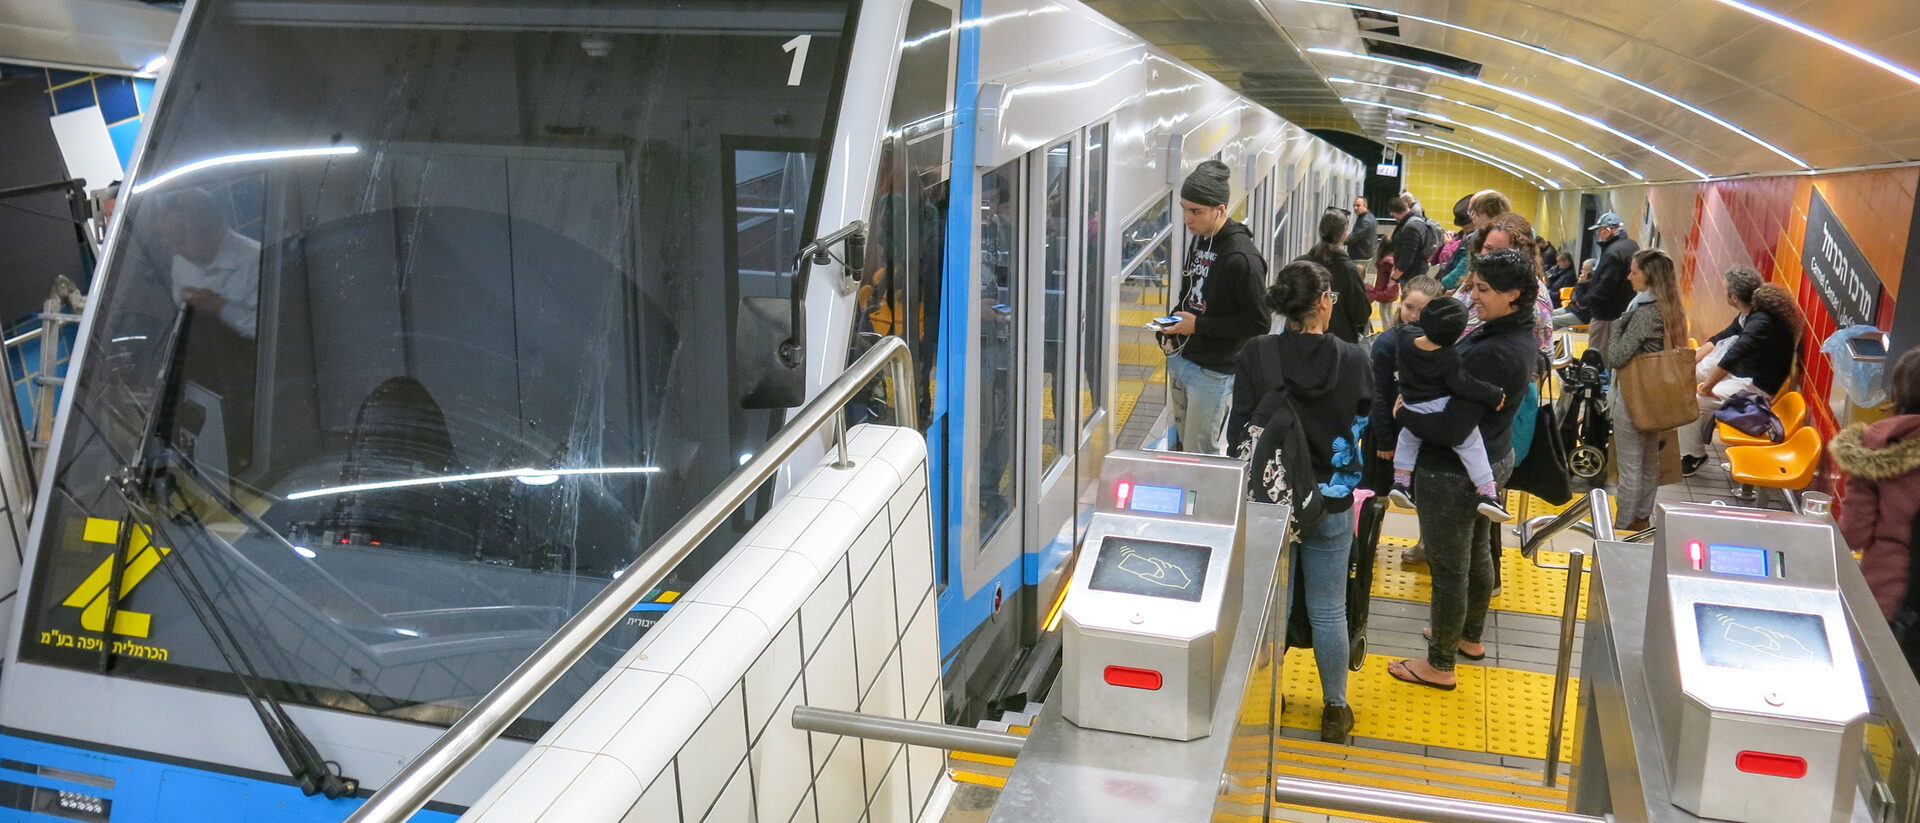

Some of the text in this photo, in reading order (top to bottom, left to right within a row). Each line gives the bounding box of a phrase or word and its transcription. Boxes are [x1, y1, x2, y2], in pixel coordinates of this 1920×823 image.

[782, 34, 812, 86] 1
[1811, 256, 1839, 311] Carmel Center
[1822, 221, 1872, 322] מרכז הכרמל
[41, 629, 74, 647] בע"מ
[112, 640, 168, 661] הכרמלית
